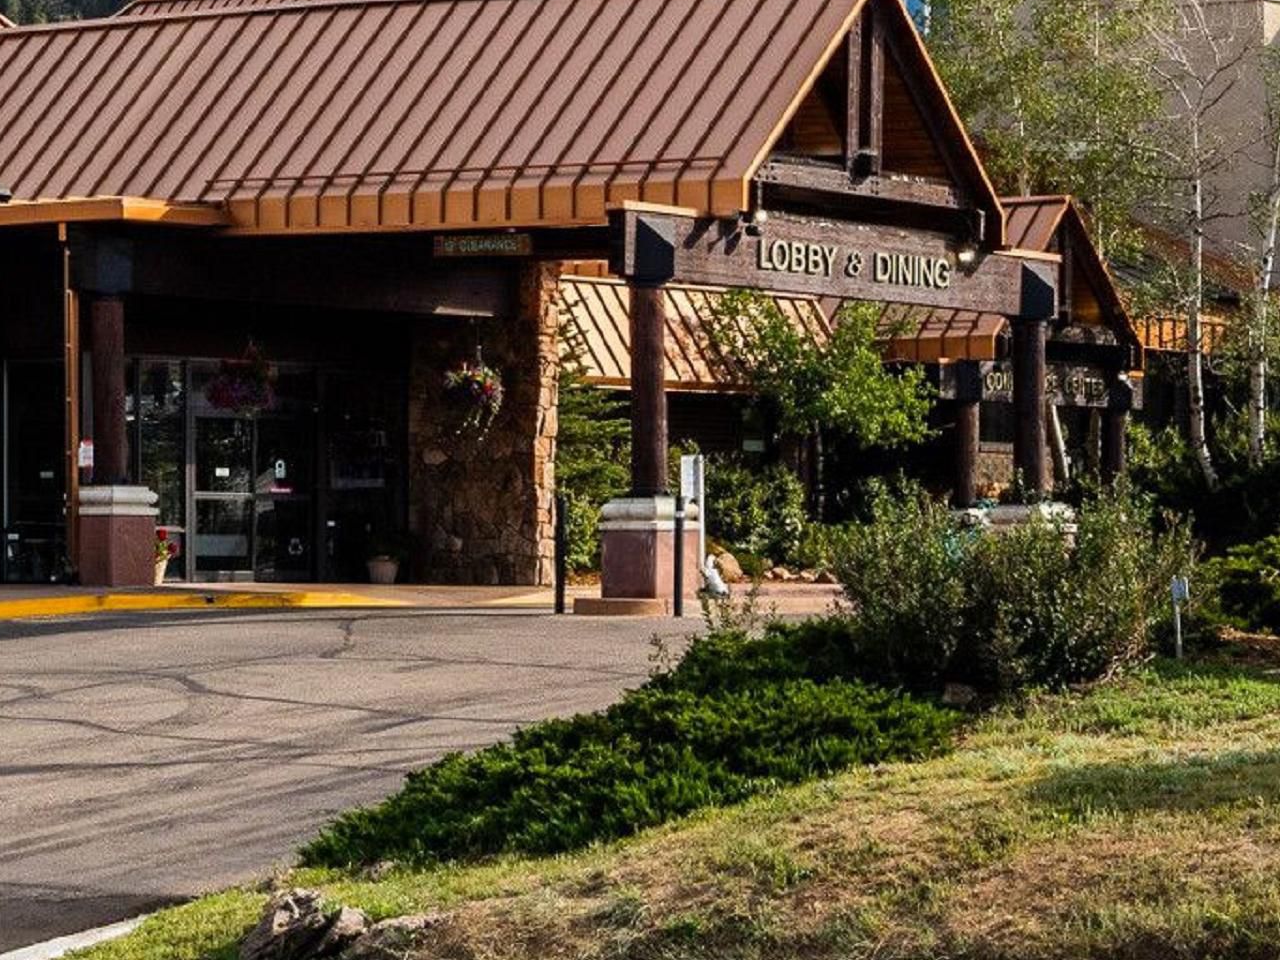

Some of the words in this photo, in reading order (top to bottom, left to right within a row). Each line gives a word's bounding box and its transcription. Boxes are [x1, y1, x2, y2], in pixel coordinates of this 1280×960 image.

[759, 238, 837, 276] LOBBY
[845, 252, 865, 277] &
[875, 252, 950, 288] DINING
